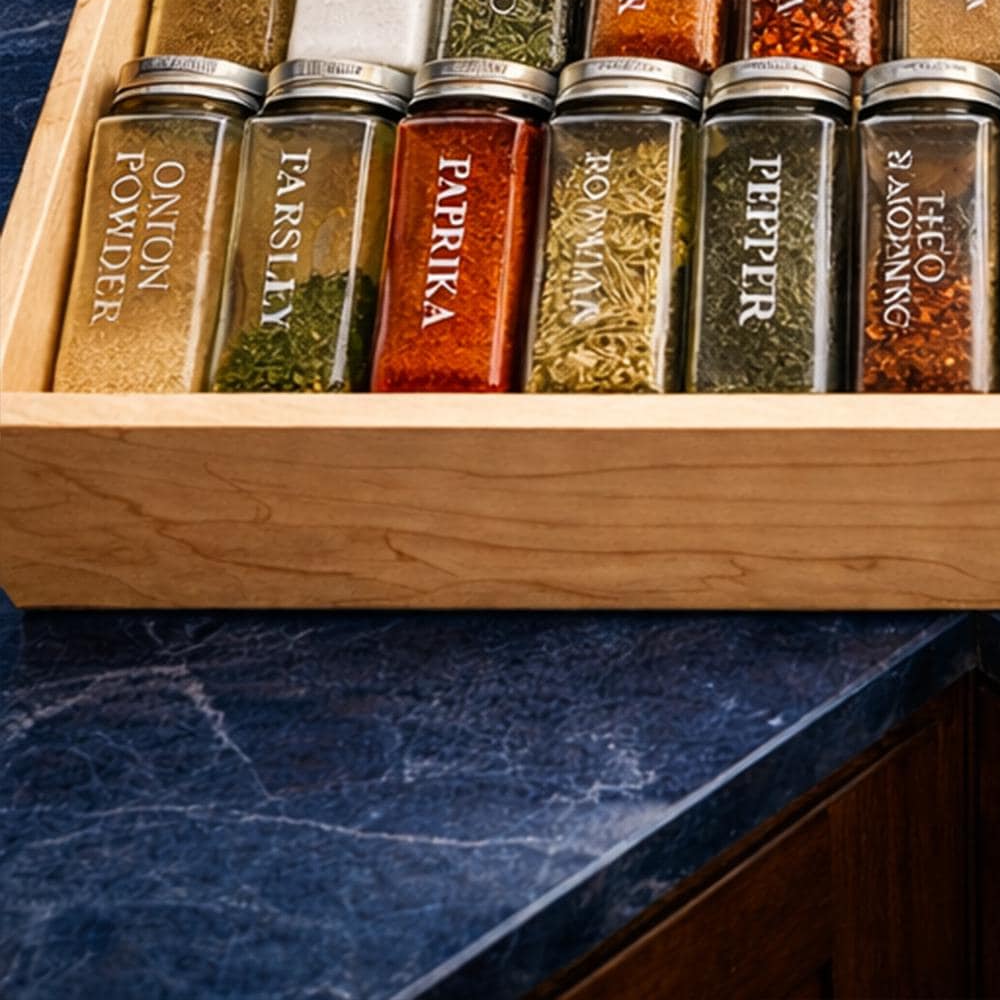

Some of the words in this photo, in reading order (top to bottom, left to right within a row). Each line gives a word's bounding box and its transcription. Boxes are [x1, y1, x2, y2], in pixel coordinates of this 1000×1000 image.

[88, 150, 146, 328] POWDER
[135, 159, 186, 291] ONION
[420, 153, 472, 330] PAPRIKA
[738, 153, 783, 327] PEPPER
